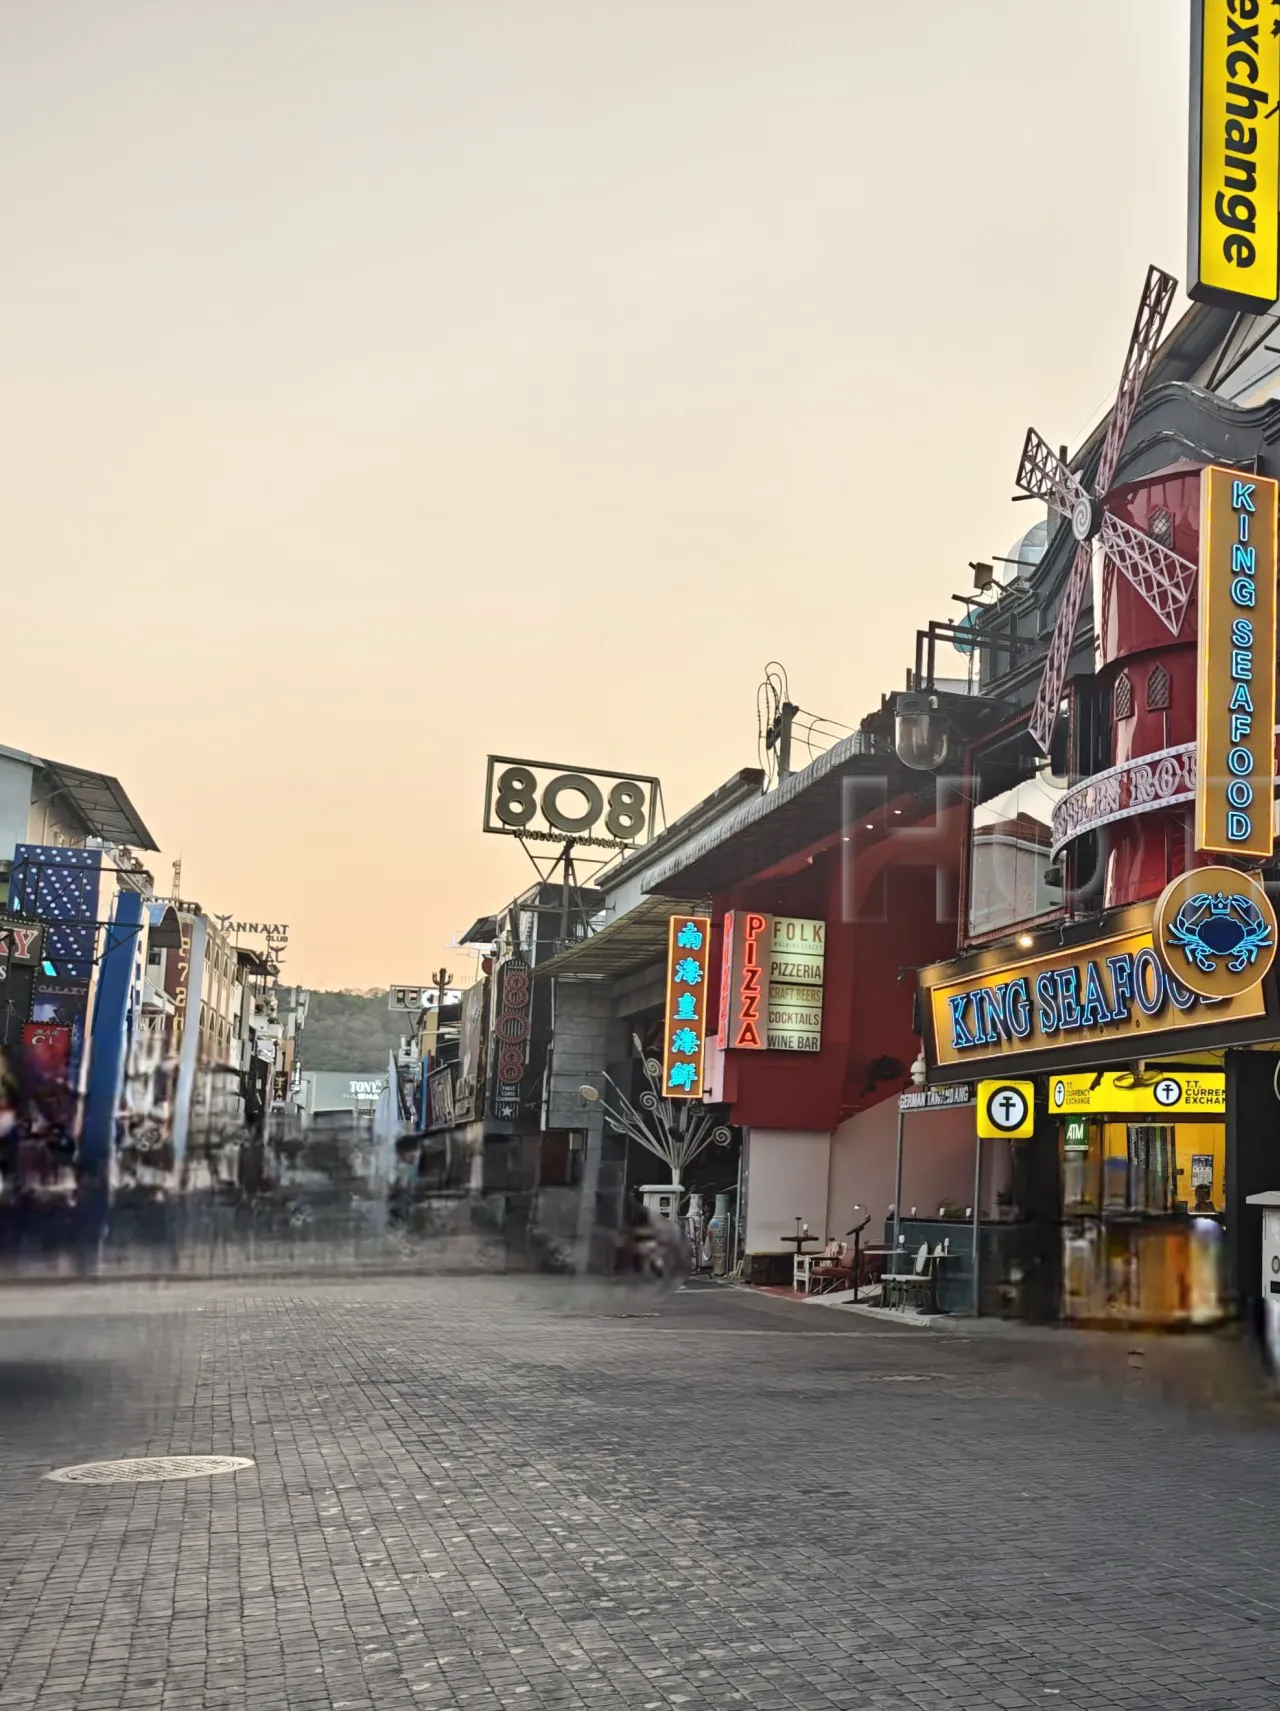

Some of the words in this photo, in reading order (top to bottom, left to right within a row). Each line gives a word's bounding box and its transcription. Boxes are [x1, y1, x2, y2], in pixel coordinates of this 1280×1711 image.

[1215, 0, 1268, 269] exchange
[1231, 480, 1256, 607] KING
[1227, 618, 1254, 841] SEAFOOD
[495, 766, 646, 839] 808
[773, 920, 823, 943] FOLK
[771, 961, 822, 979] PIZZERIA
[736, 914, 766, 1047] PIZZA
[38, 985, 88, 996] GALAXY
[769, 986, 794, 999] CRAFT
[796, 988, 821, 1002] BEERS
[1036, 947, 1228, 1034] SEAFO
[769, 1011, 819, 1026] COCKTAILS
[947, 979, 1030, 1049] KING
[495, 971, 531, 1084] 808
[768, 1034, 794, 1048] WINE
[797, 1035, 819, 1050] BAR
[1066, 1089, 1091, 1097] CURRENCY
[1185, 1080, 1202, 1088] T.T.
[900, 1091, 926, 1109] GERMAN
[1066, 1097, 1091, 1105] EXCHANGE
[1066, 1123, 1084, 1140] ATM
